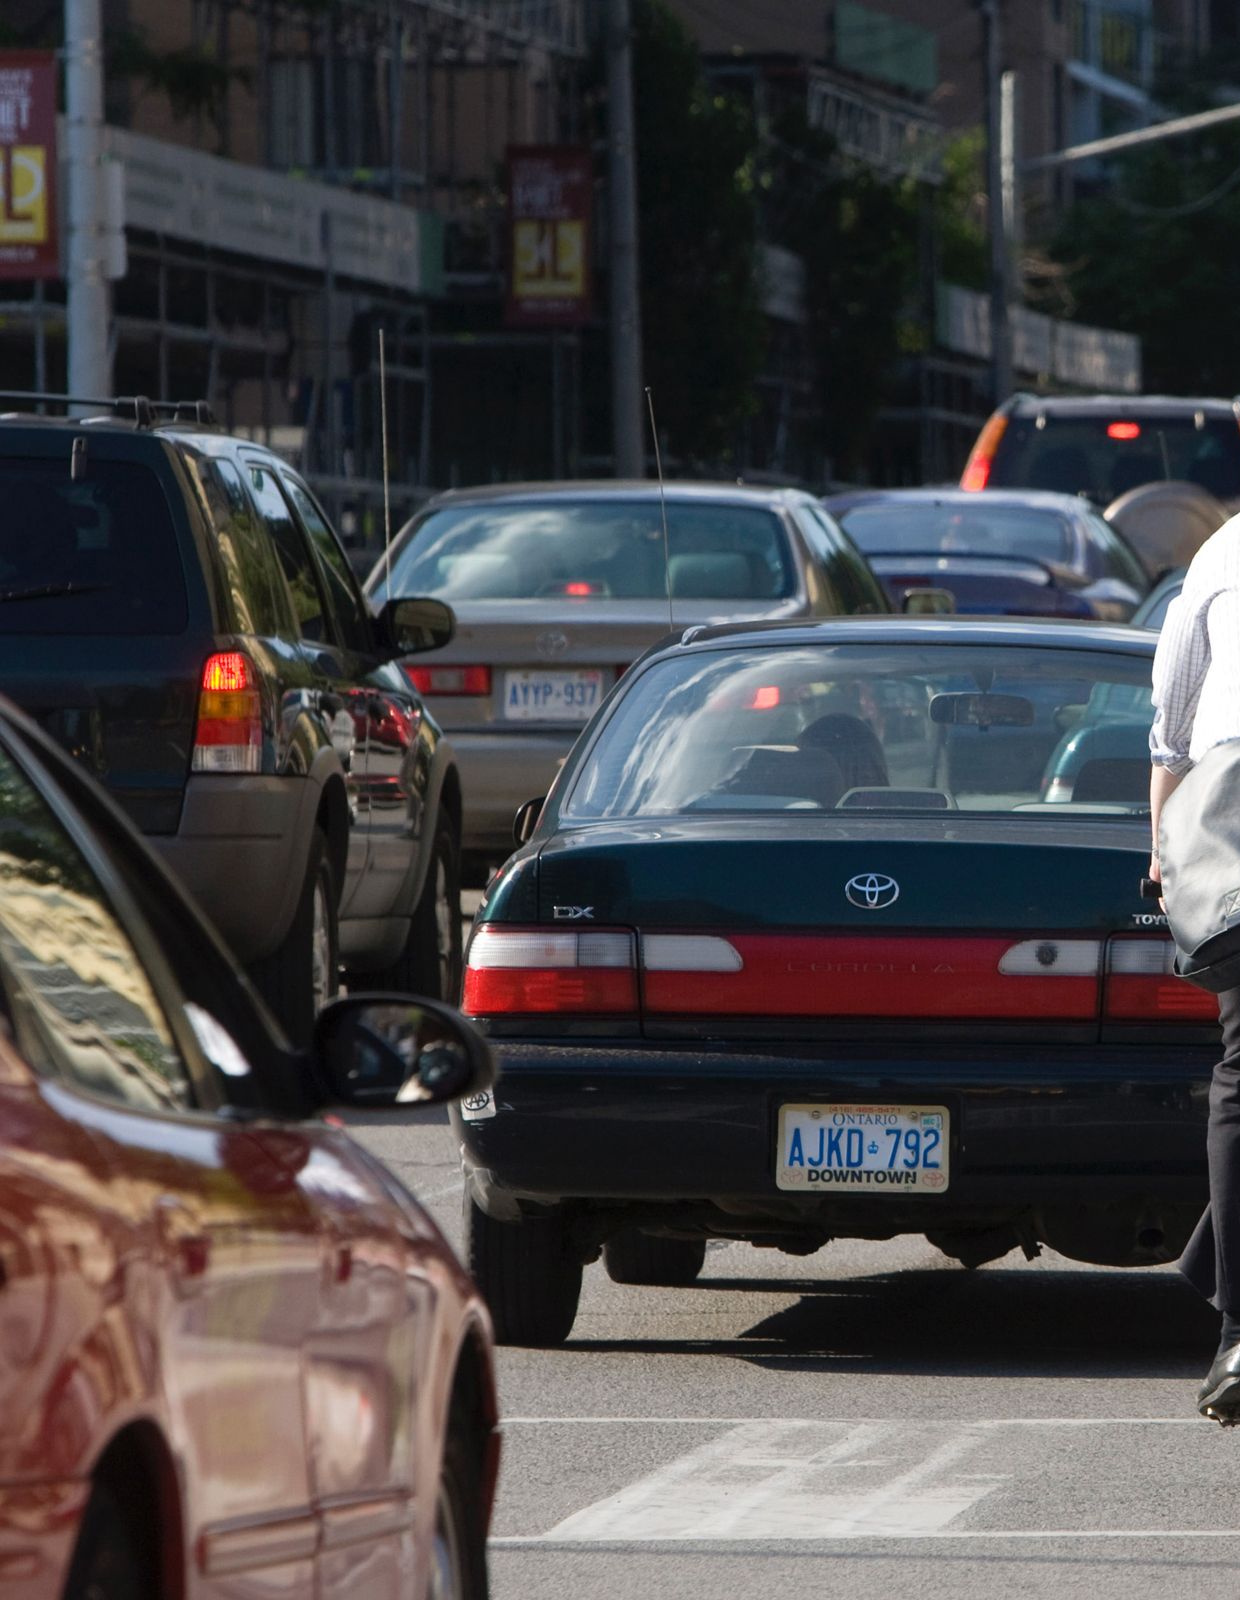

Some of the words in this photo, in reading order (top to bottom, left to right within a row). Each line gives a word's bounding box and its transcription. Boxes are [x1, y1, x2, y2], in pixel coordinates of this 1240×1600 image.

[553, 905, 594, 919] DX
[1132, 914, 1169, 925] TOYO
[832, 1112, 898, 1127] ONTARIO
[788, 1127, 864, 1168] AJKD
[885, 1128, 940, 1169] 792
[807, 1169, 917, 1185] DOWNTOWN
